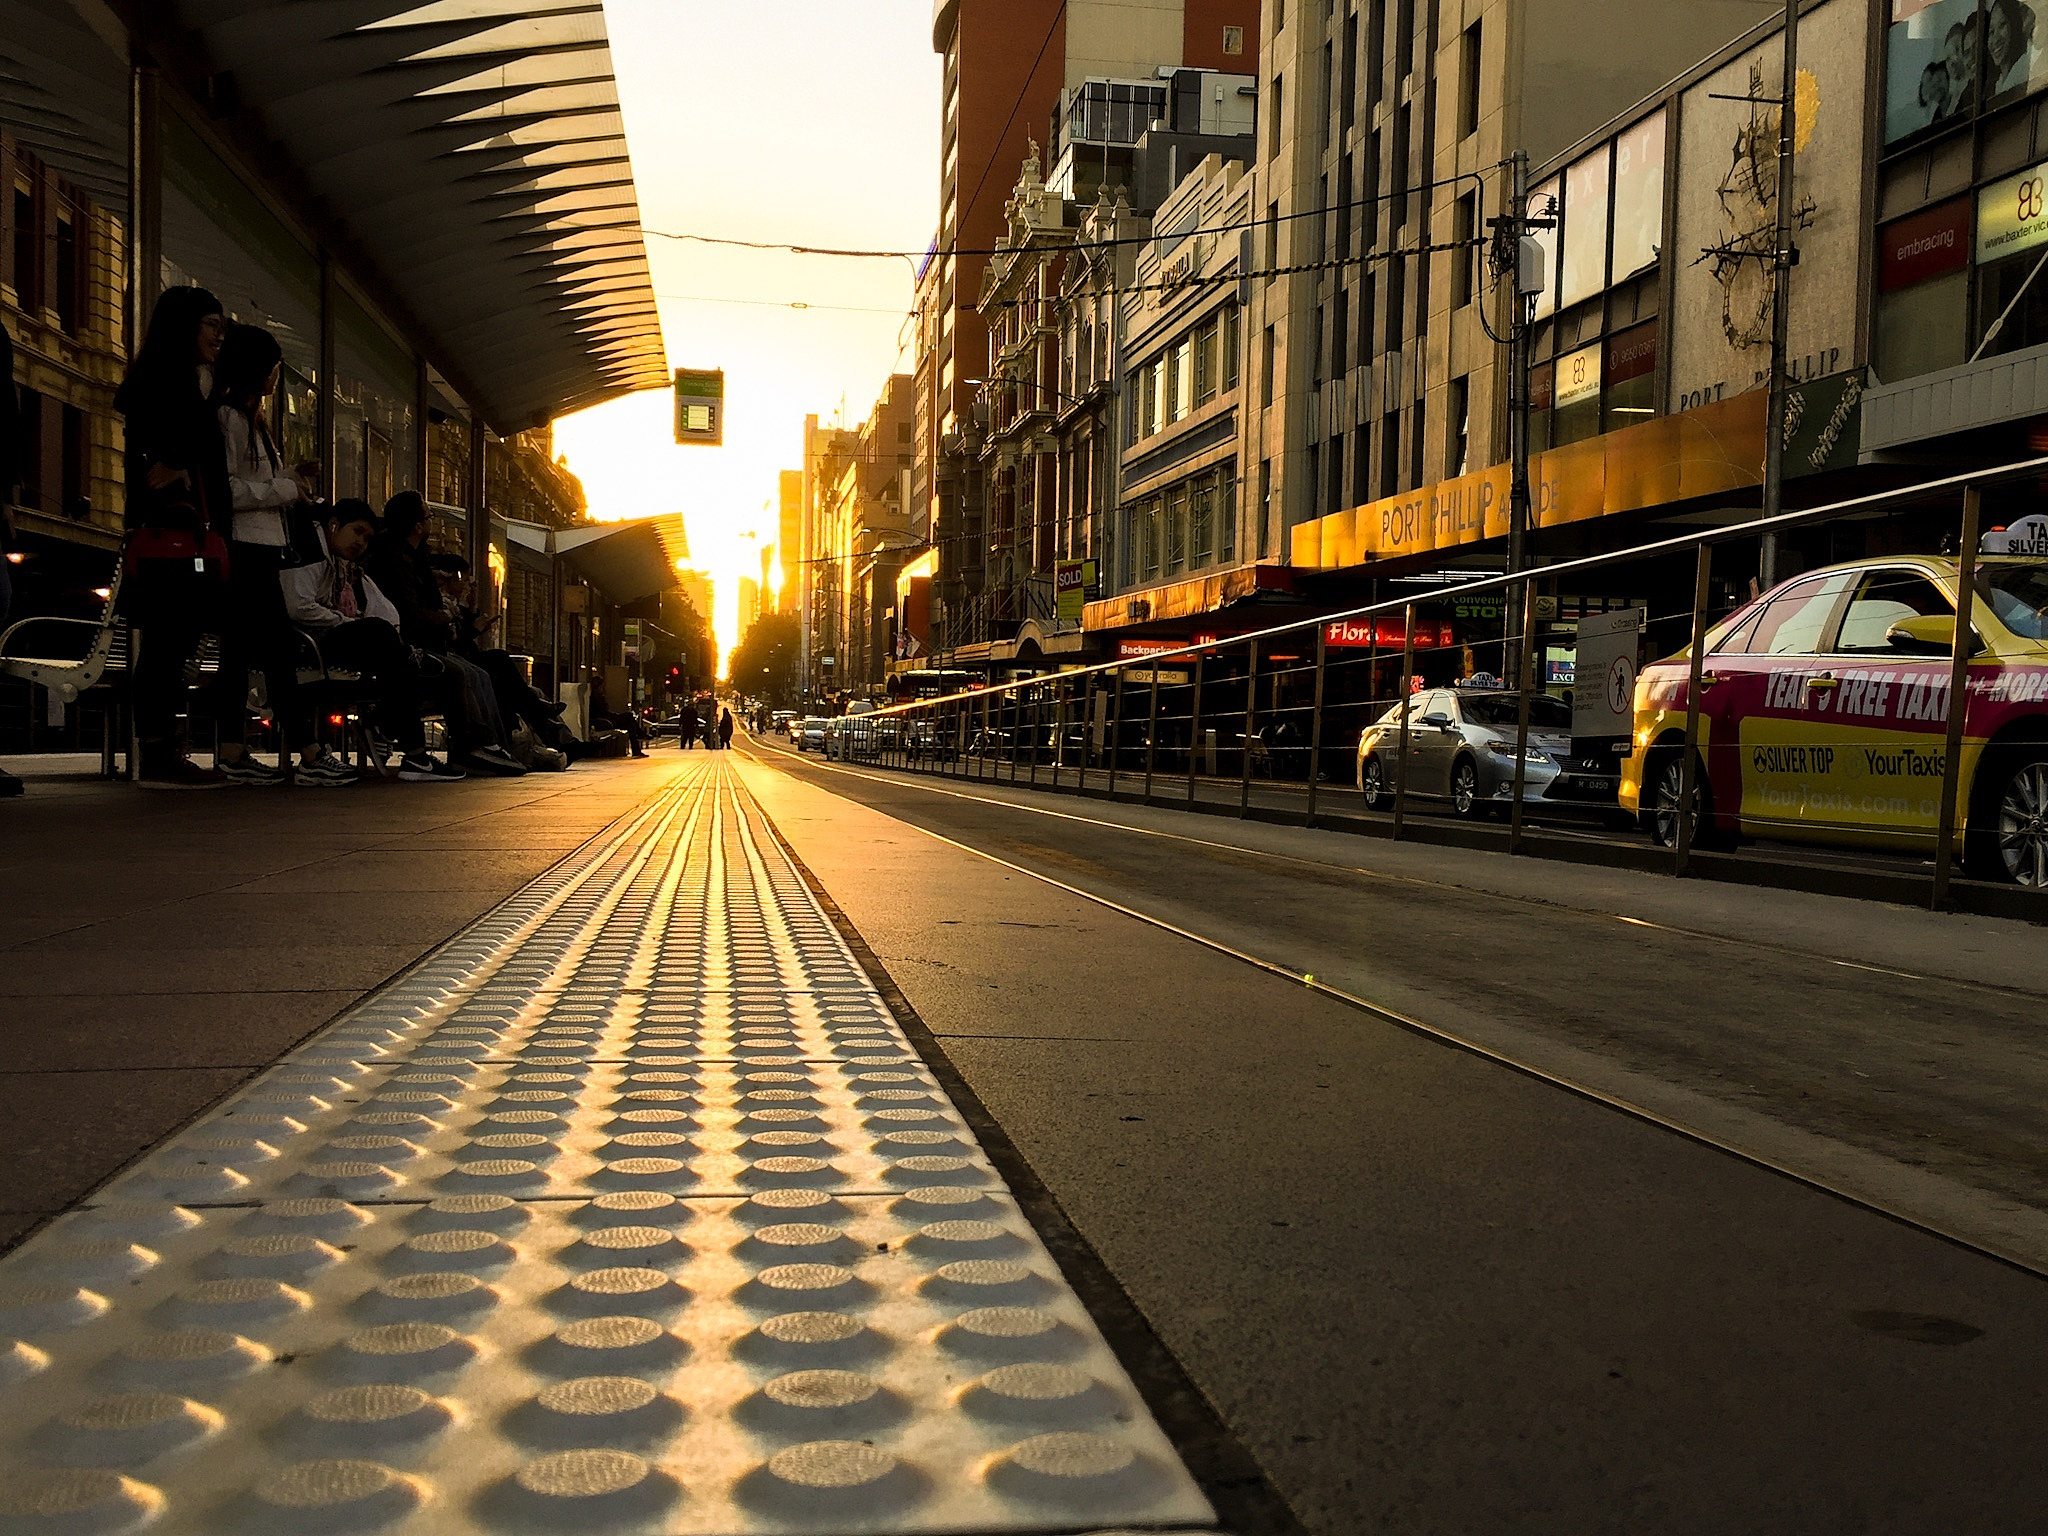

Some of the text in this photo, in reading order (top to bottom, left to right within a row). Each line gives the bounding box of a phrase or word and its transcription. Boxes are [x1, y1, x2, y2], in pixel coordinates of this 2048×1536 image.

[1897, 229, 1955, 261] embracing
[1984, 219, 2048, 250] www.baxter.vic.
[1680, 381, 1726, 412] PORT
[1382, 500, 1423, 547] PORT
[1429, 481, 1494, 537] PHILLIP
[1058, 569, 1082, 587] SOLD
[1836, 670, 1896, 717] FREE
[1767, 747, 1946, 777] SILVER TOP YourTaxis
[1757, 781, 1941, 818] YourTaxis.com.a
